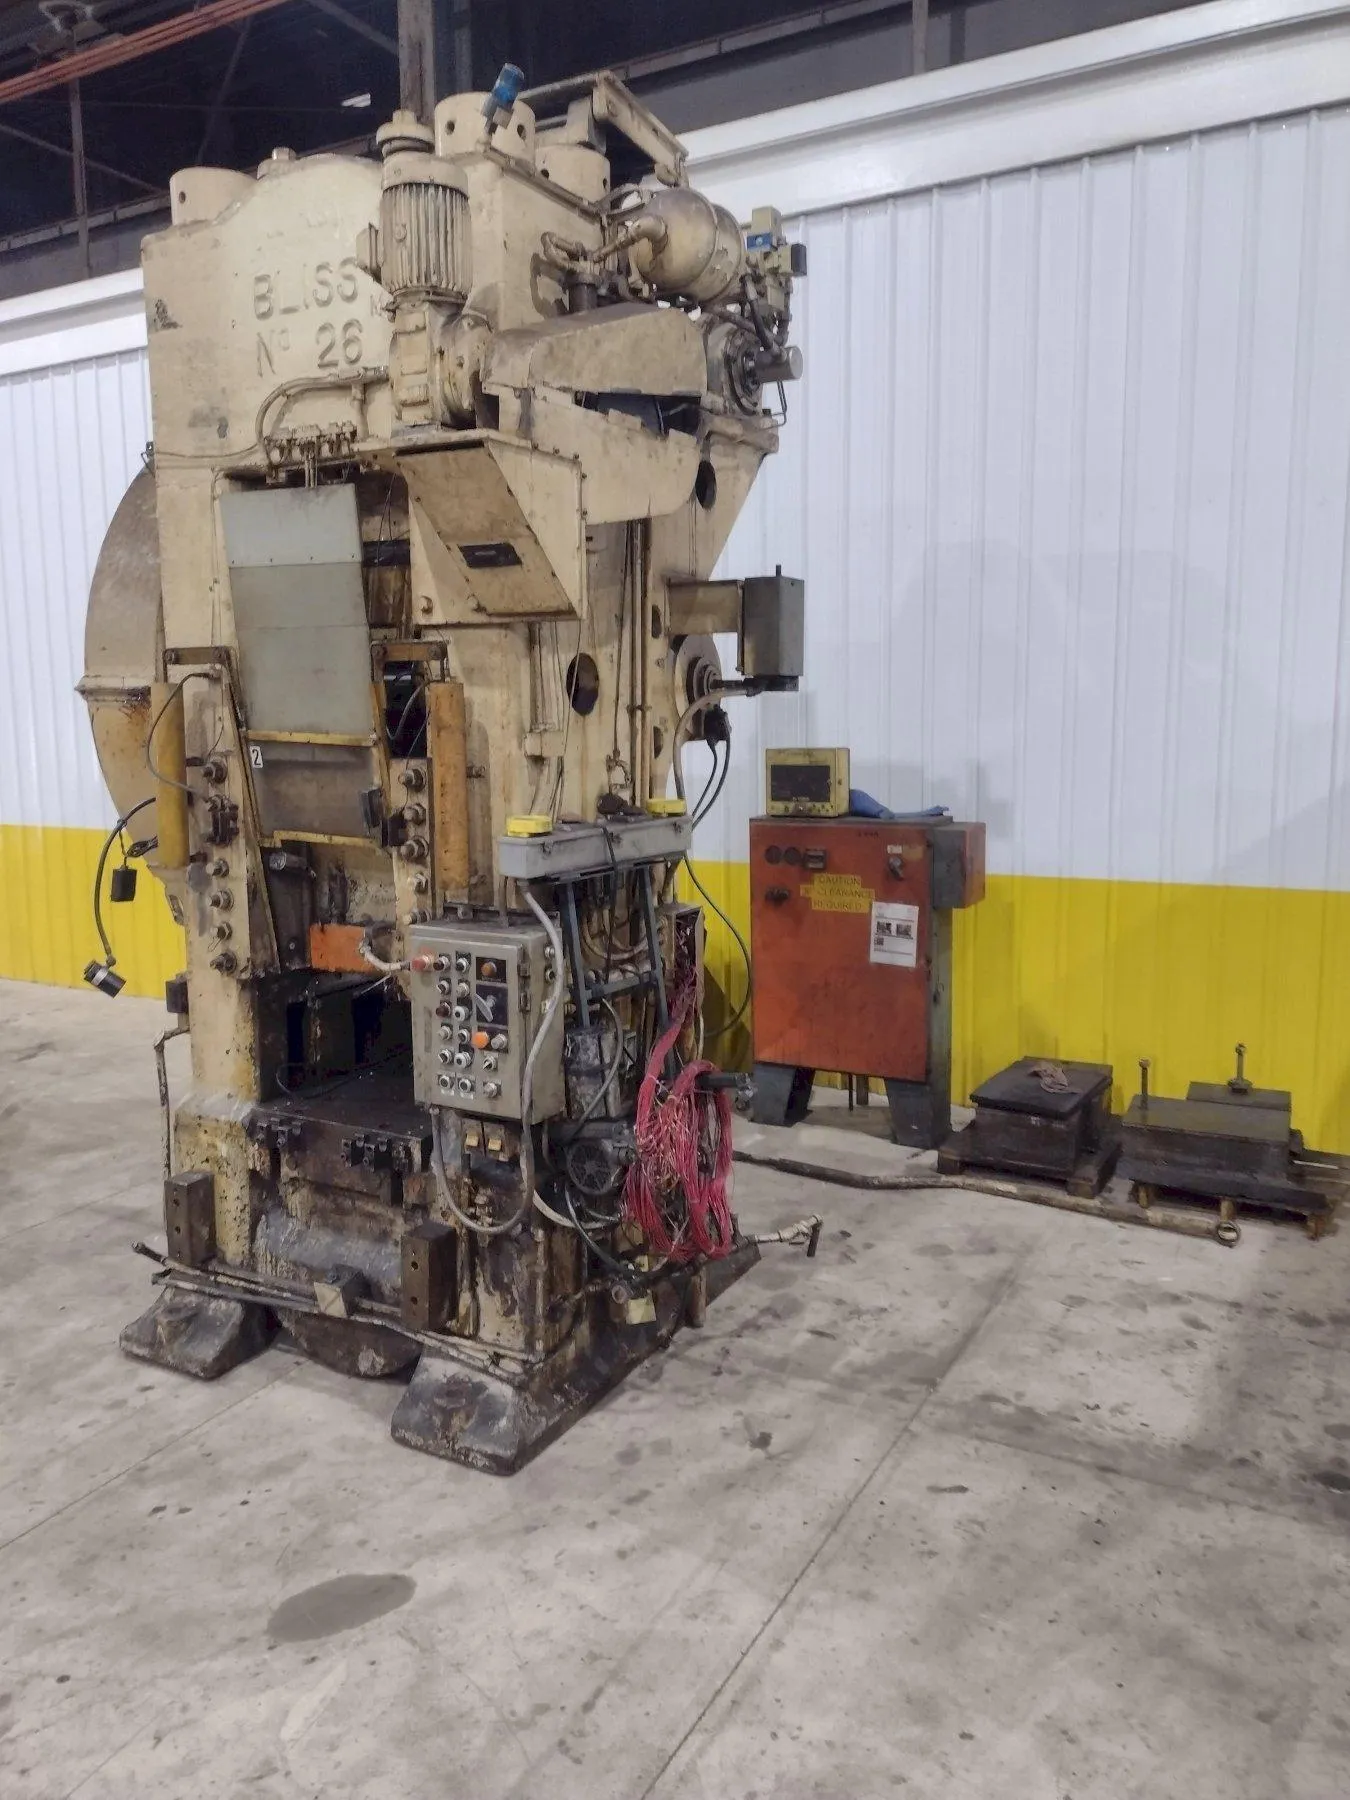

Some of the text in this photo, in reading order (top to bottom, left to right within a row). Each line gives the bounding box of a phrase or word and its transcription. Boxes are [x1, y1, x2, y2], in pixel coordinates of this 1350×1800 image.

[254, 256, 359, 321] BLISS
[316, 318, 363, 369] 26
[251, 748, 262, 766] 2
[819, 874, 860, 885] CAUTION
